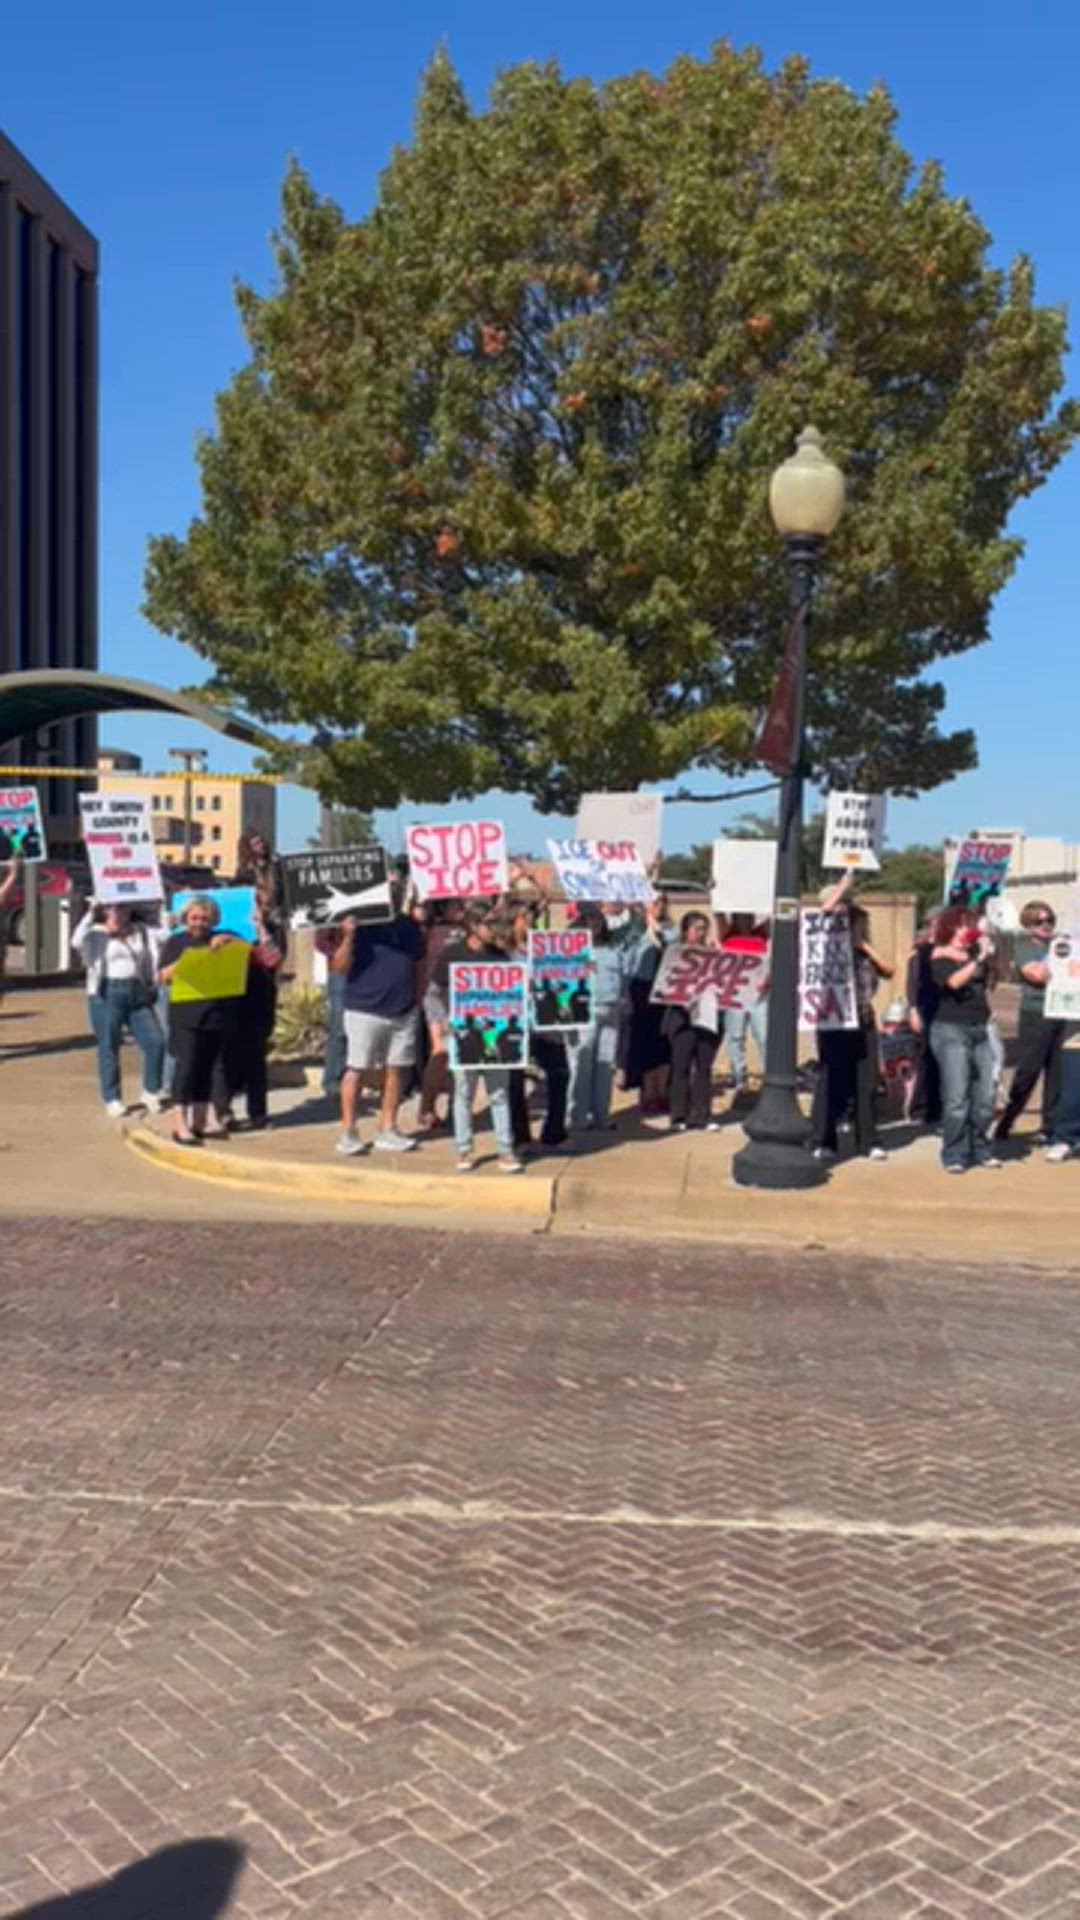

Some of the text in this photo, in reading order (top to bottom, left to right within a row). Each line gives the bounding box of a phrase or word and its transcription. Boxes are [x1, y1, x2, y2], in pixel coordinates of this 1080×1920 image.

[92, 815, 139, 829] COUNTY
[409, 821, 502, 870] STOP
[960, 841, 1012, 864] STOP
[298, 863, 375, 887] FAMILIES
[428, 860, 501, 897] ICE
[531, 930, 588, 957] STOP
[670, 948, 763, 978] STOP
[453, 965, 524, 993] STOP
